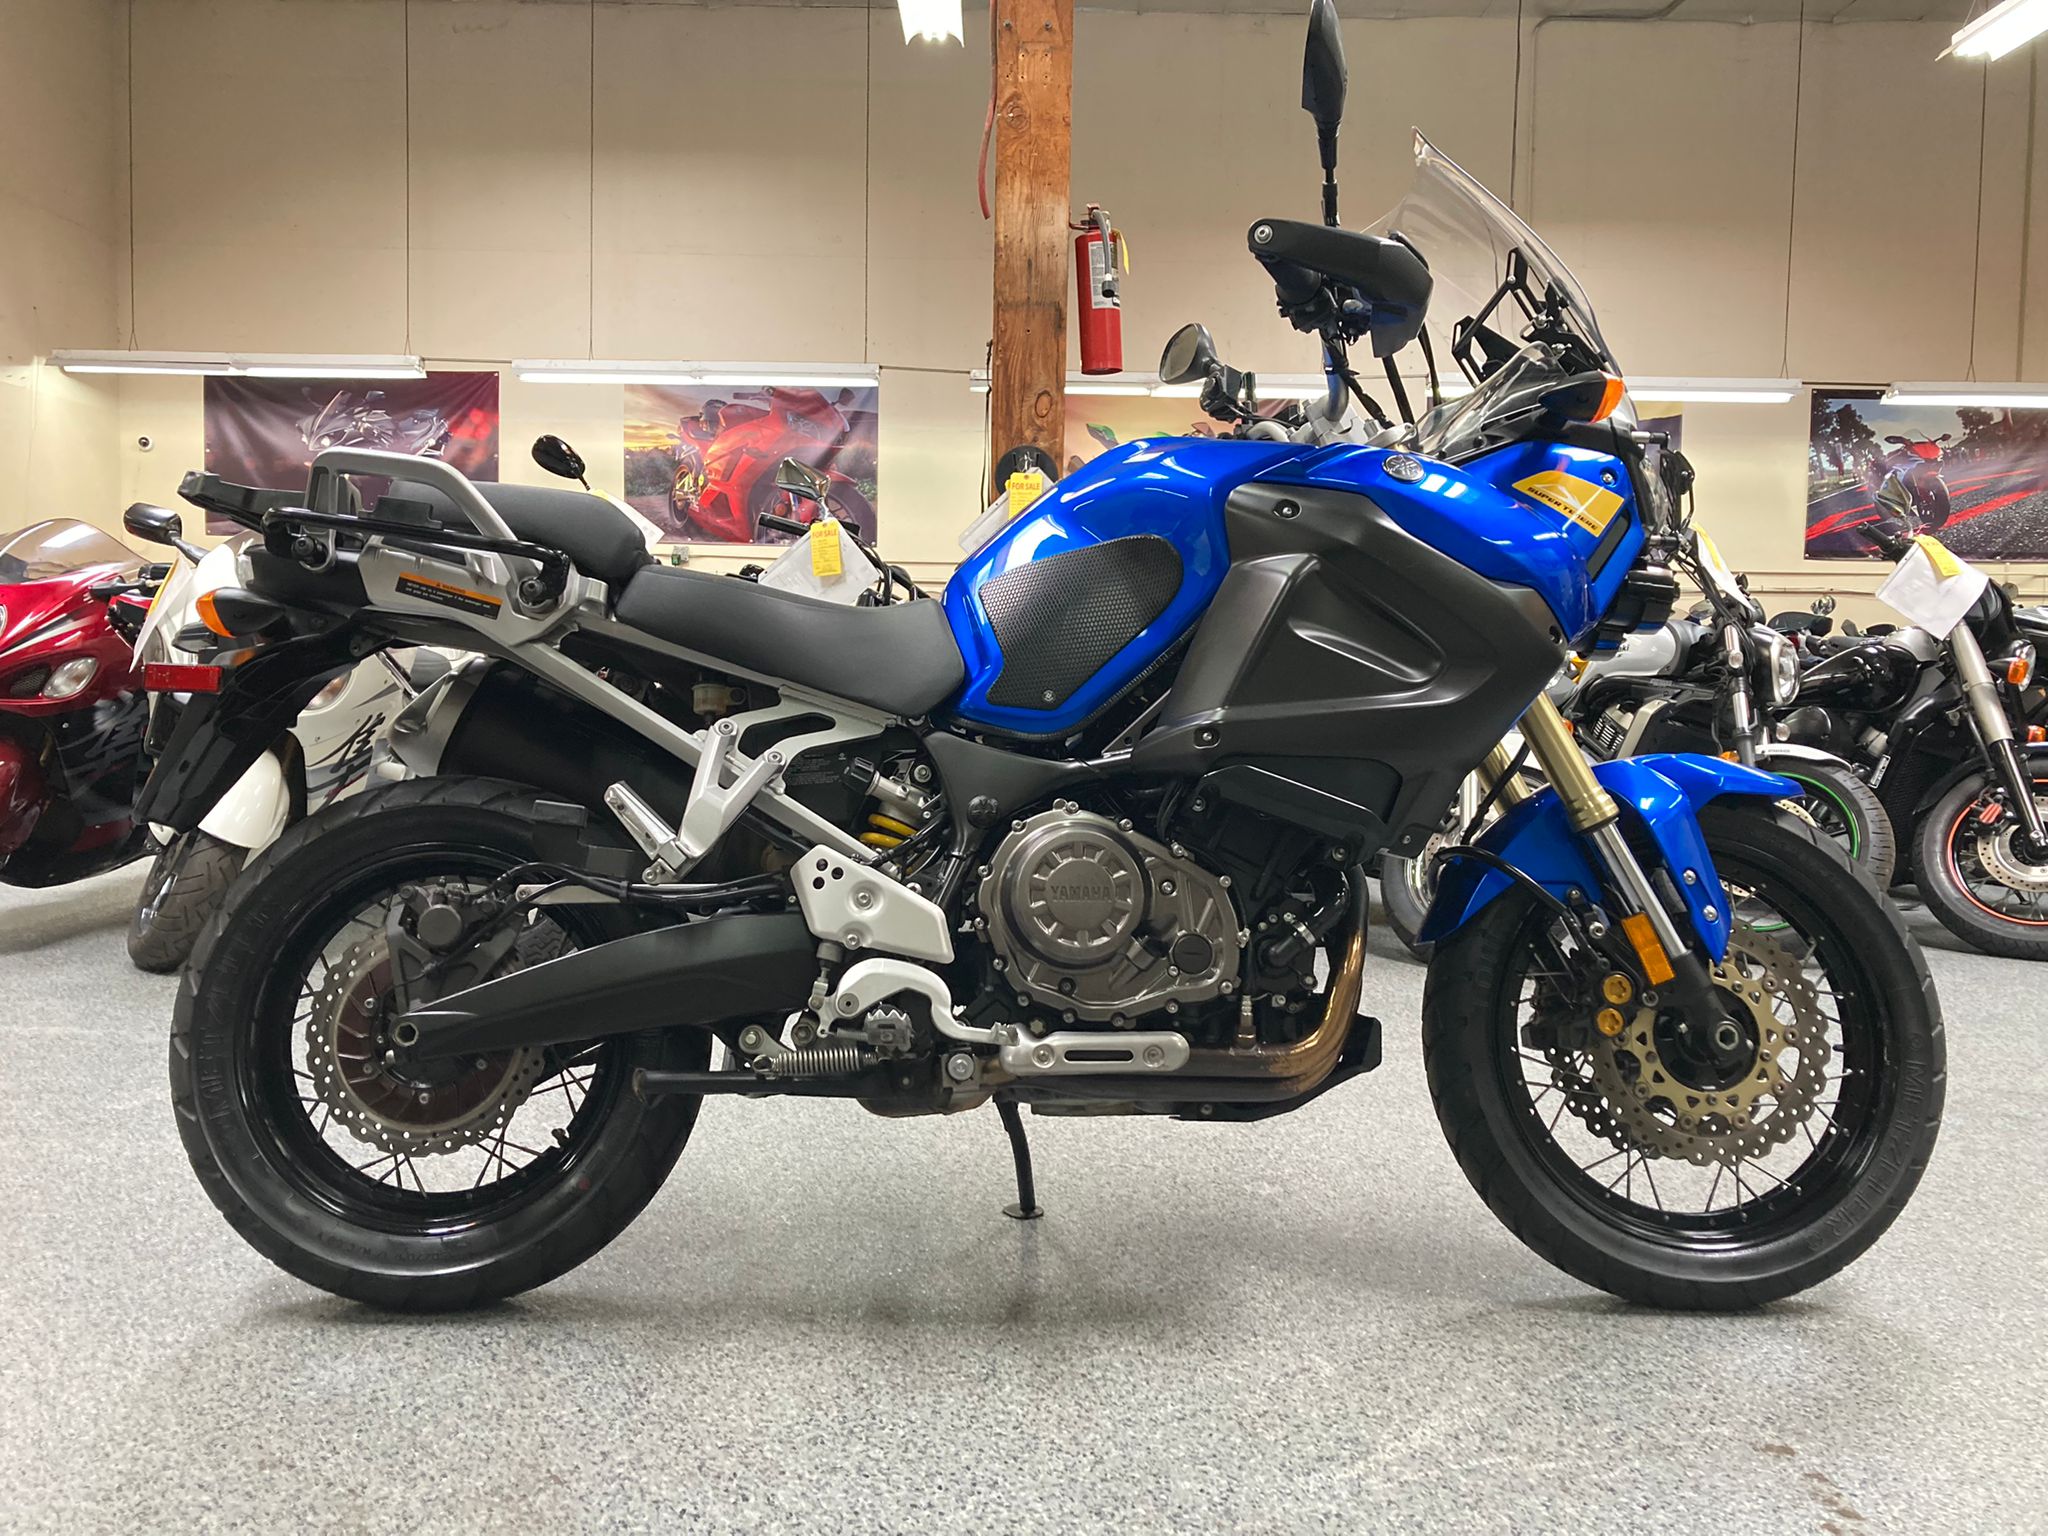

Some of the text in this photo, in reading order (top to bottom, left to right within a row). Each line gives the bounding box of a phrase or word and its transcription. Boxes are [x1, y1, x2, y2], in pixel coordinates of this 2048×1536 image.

[1012, 482, 1040, 490] FOR SALE
[1527, 486, 1561, 507] SUPER
[812, 529, 837, 539] FOR SALE
[1050, 885, 1113, 902] YAMAHA
[1824, 1059, 1927, 1237] METZELER
